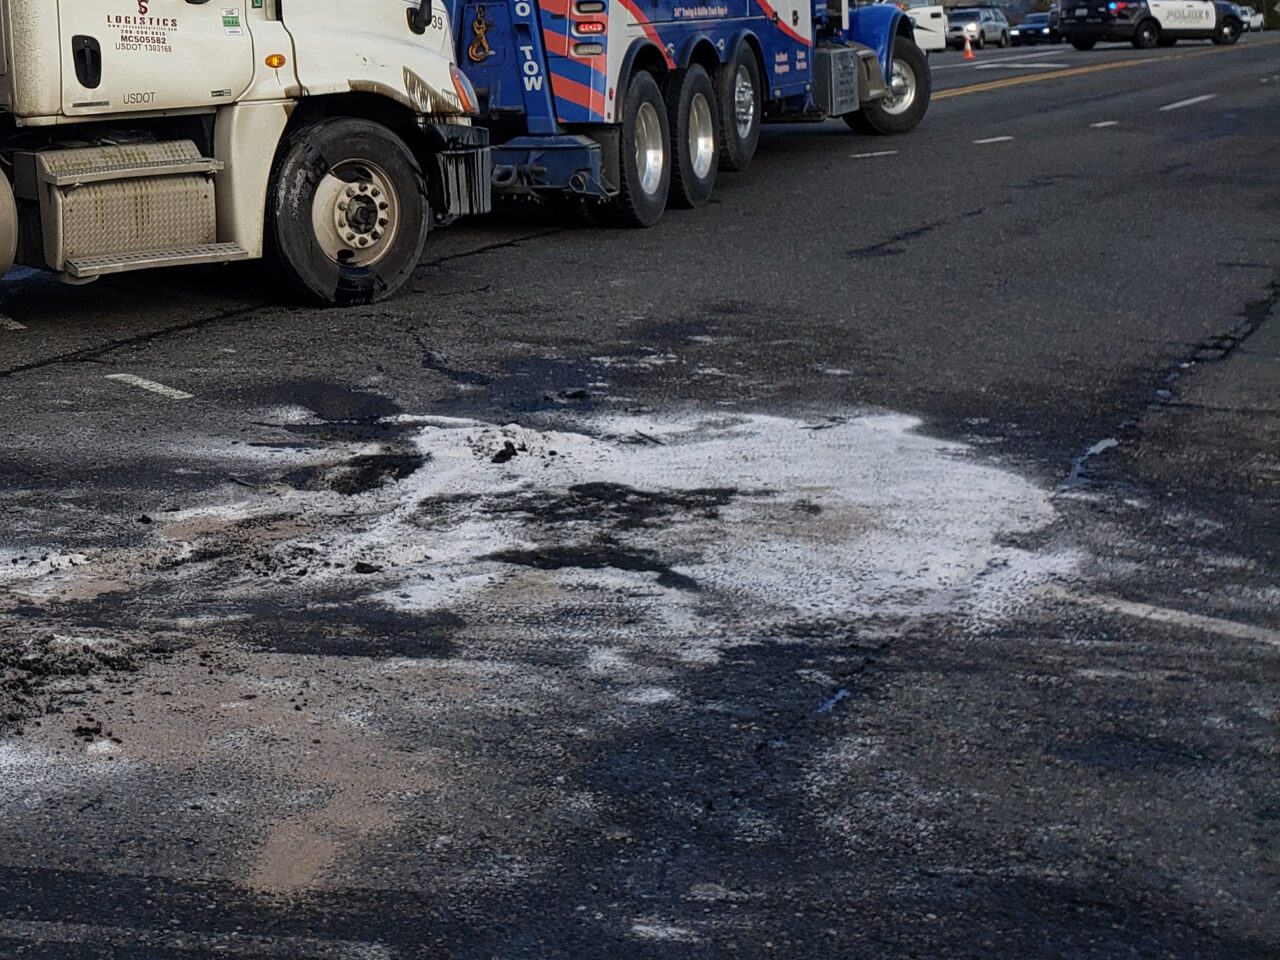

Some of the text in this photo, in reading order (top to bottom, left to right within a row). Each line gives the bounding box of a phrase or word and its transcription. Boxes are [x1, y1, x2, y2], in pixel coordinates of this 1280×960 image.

[107, 14, 177, 27] LOGISTICS
[432, 15, 443, 30] 39
[121, 35, 166, 44] MC505582
[115, 43, 172, 53] USDOT 1303168
[520, 45, 543, 91] TOW
[123, 92, 156, 104] USDOT
